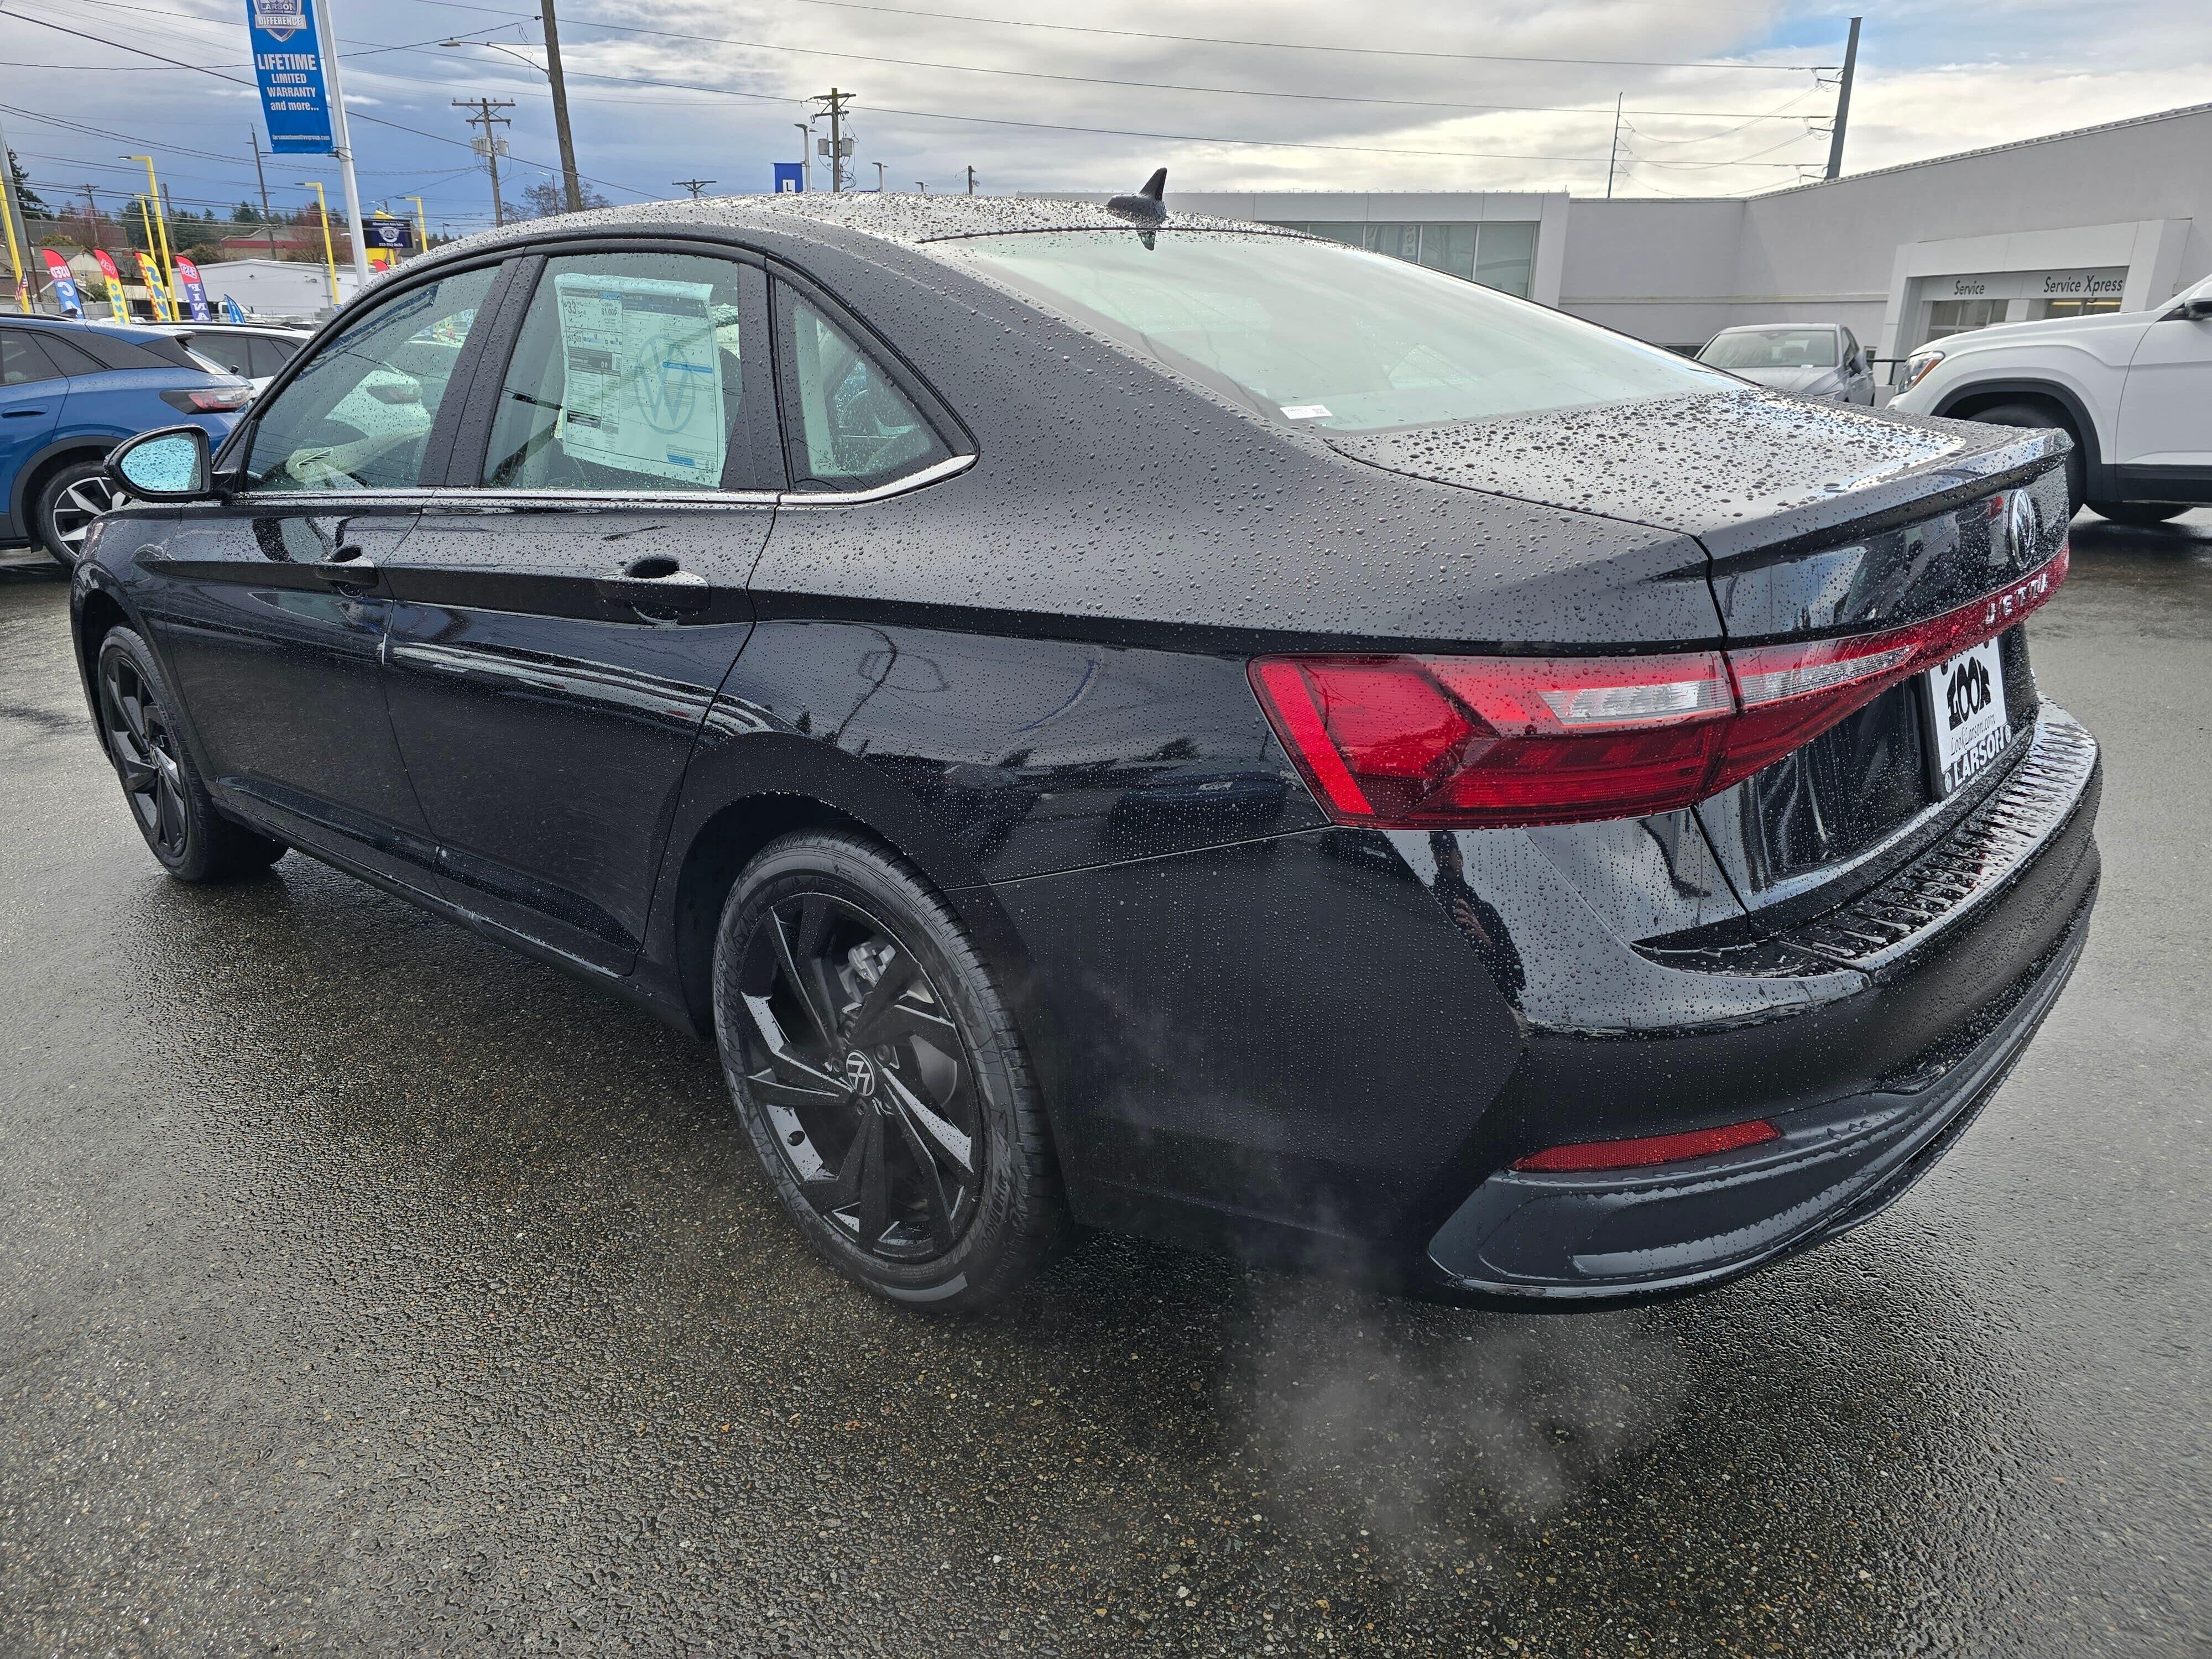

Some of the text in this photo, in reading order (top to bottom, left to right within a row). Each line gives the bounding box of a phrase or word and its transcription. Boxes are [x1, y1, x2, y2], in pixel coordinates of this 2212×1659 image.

[259, 16, 304, 27] DIFFERENCE
[257, 54, 317, 70] LIFETIME
[271, 74, 307, 84] LIMITED
[267, 87, 316, 97] WARRANTY
[270, 100, 319, 111] and more...
[1954, 280, 1985, 295] Service
[2043, 275, 2123, 296] Service Xpress
[1985, 573, 2048, 624] JETTA
[1951, 714, 1995, 756] LookLarson.com
[1954, 726, 2005, 787] LARSON
